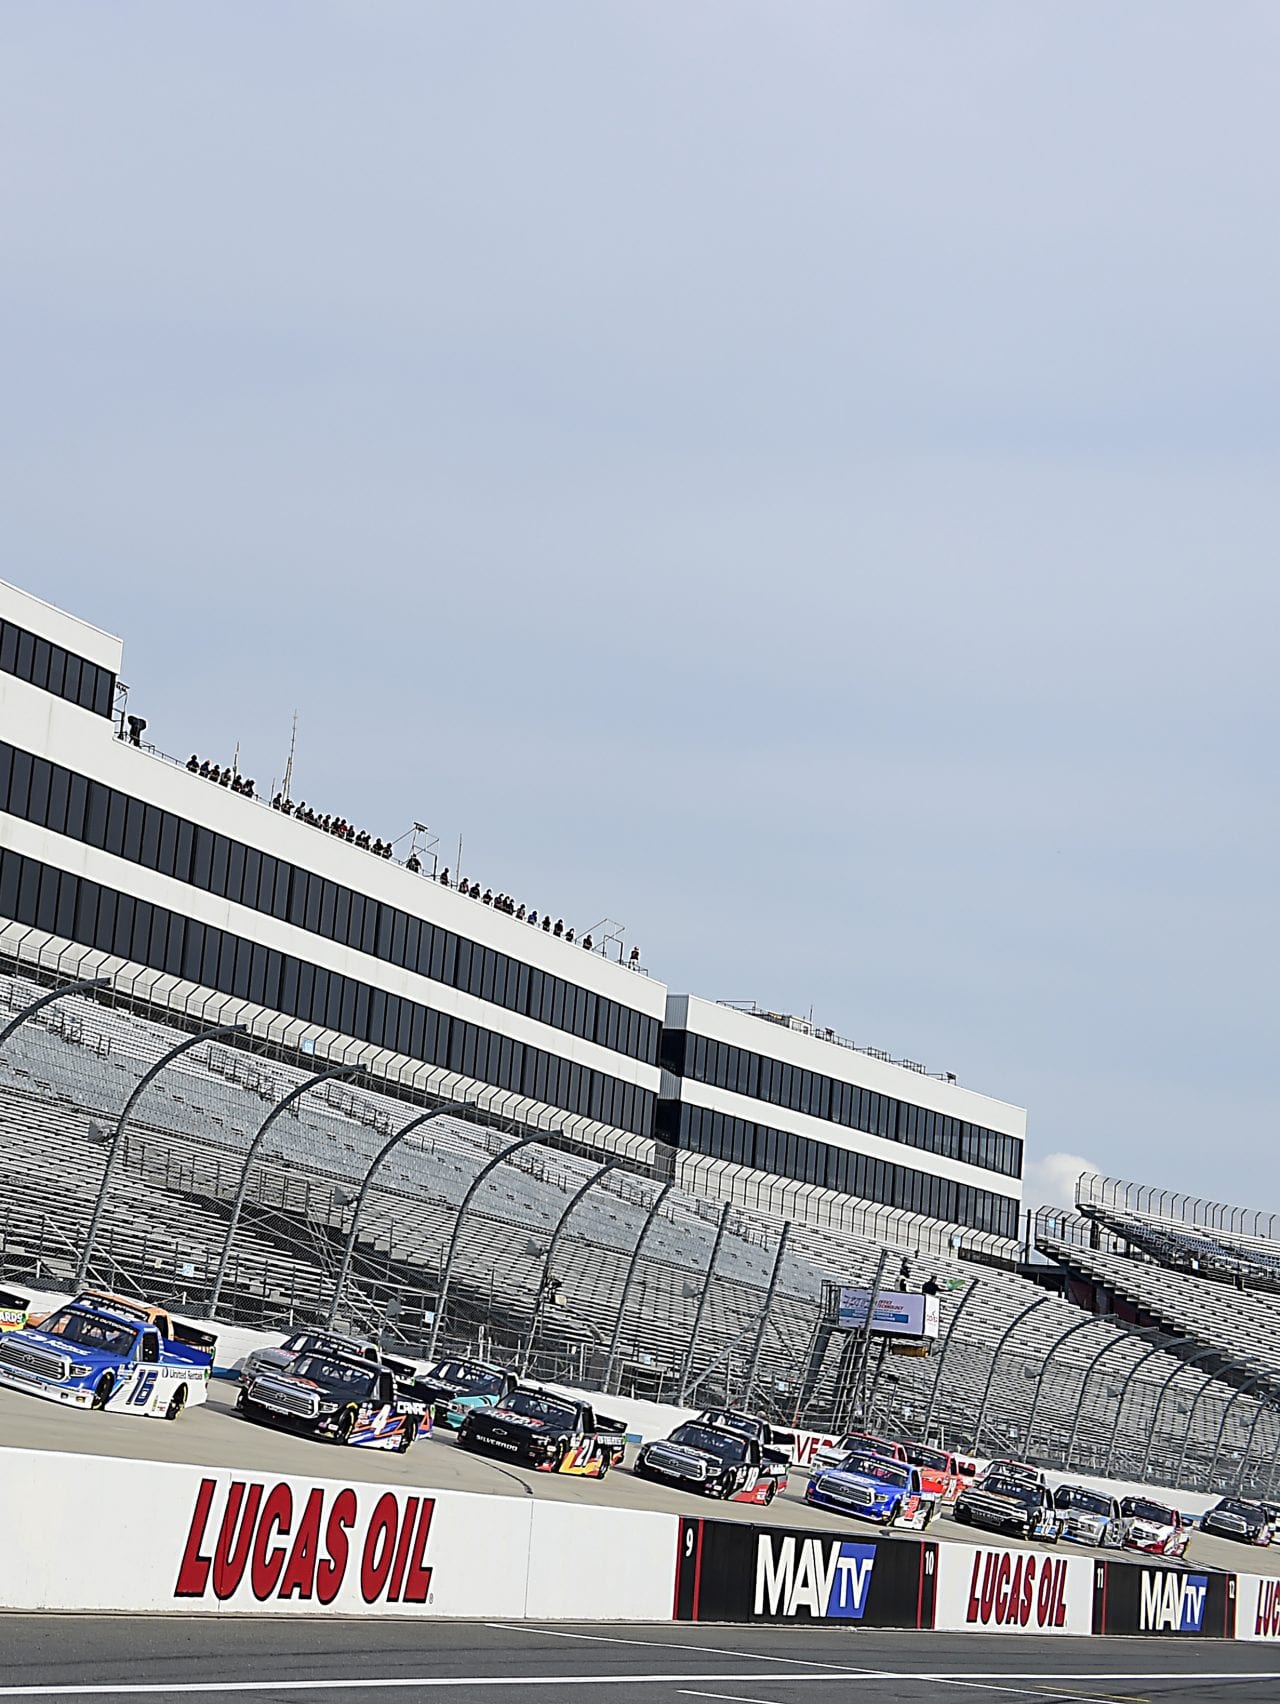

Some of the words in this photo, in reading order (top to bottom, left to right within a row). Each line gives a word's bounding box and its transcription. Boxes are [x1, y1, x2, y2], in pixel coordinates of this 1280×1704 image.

[125, 1369, 159, 1406] 16
[371, 1404, 391, 1436] 4
[476, 1434, 518, 1452] SILVERADO
[576, 1439, 594, 1466] 21
[173, 1478, 358, 1605] LUCAS
[360, 1492, 436, 1604] OIL
[685, 1528, 694, 1557] 9
[924, 1550, 935, 1576] 10
[1097, 1567, 1104, 1589] 11
[966, 1550, 1036, 1627] LUCAS
[1037, 1556, 1068, 1628] OIL
[1254, 1579, 1280, 1637] LUC
